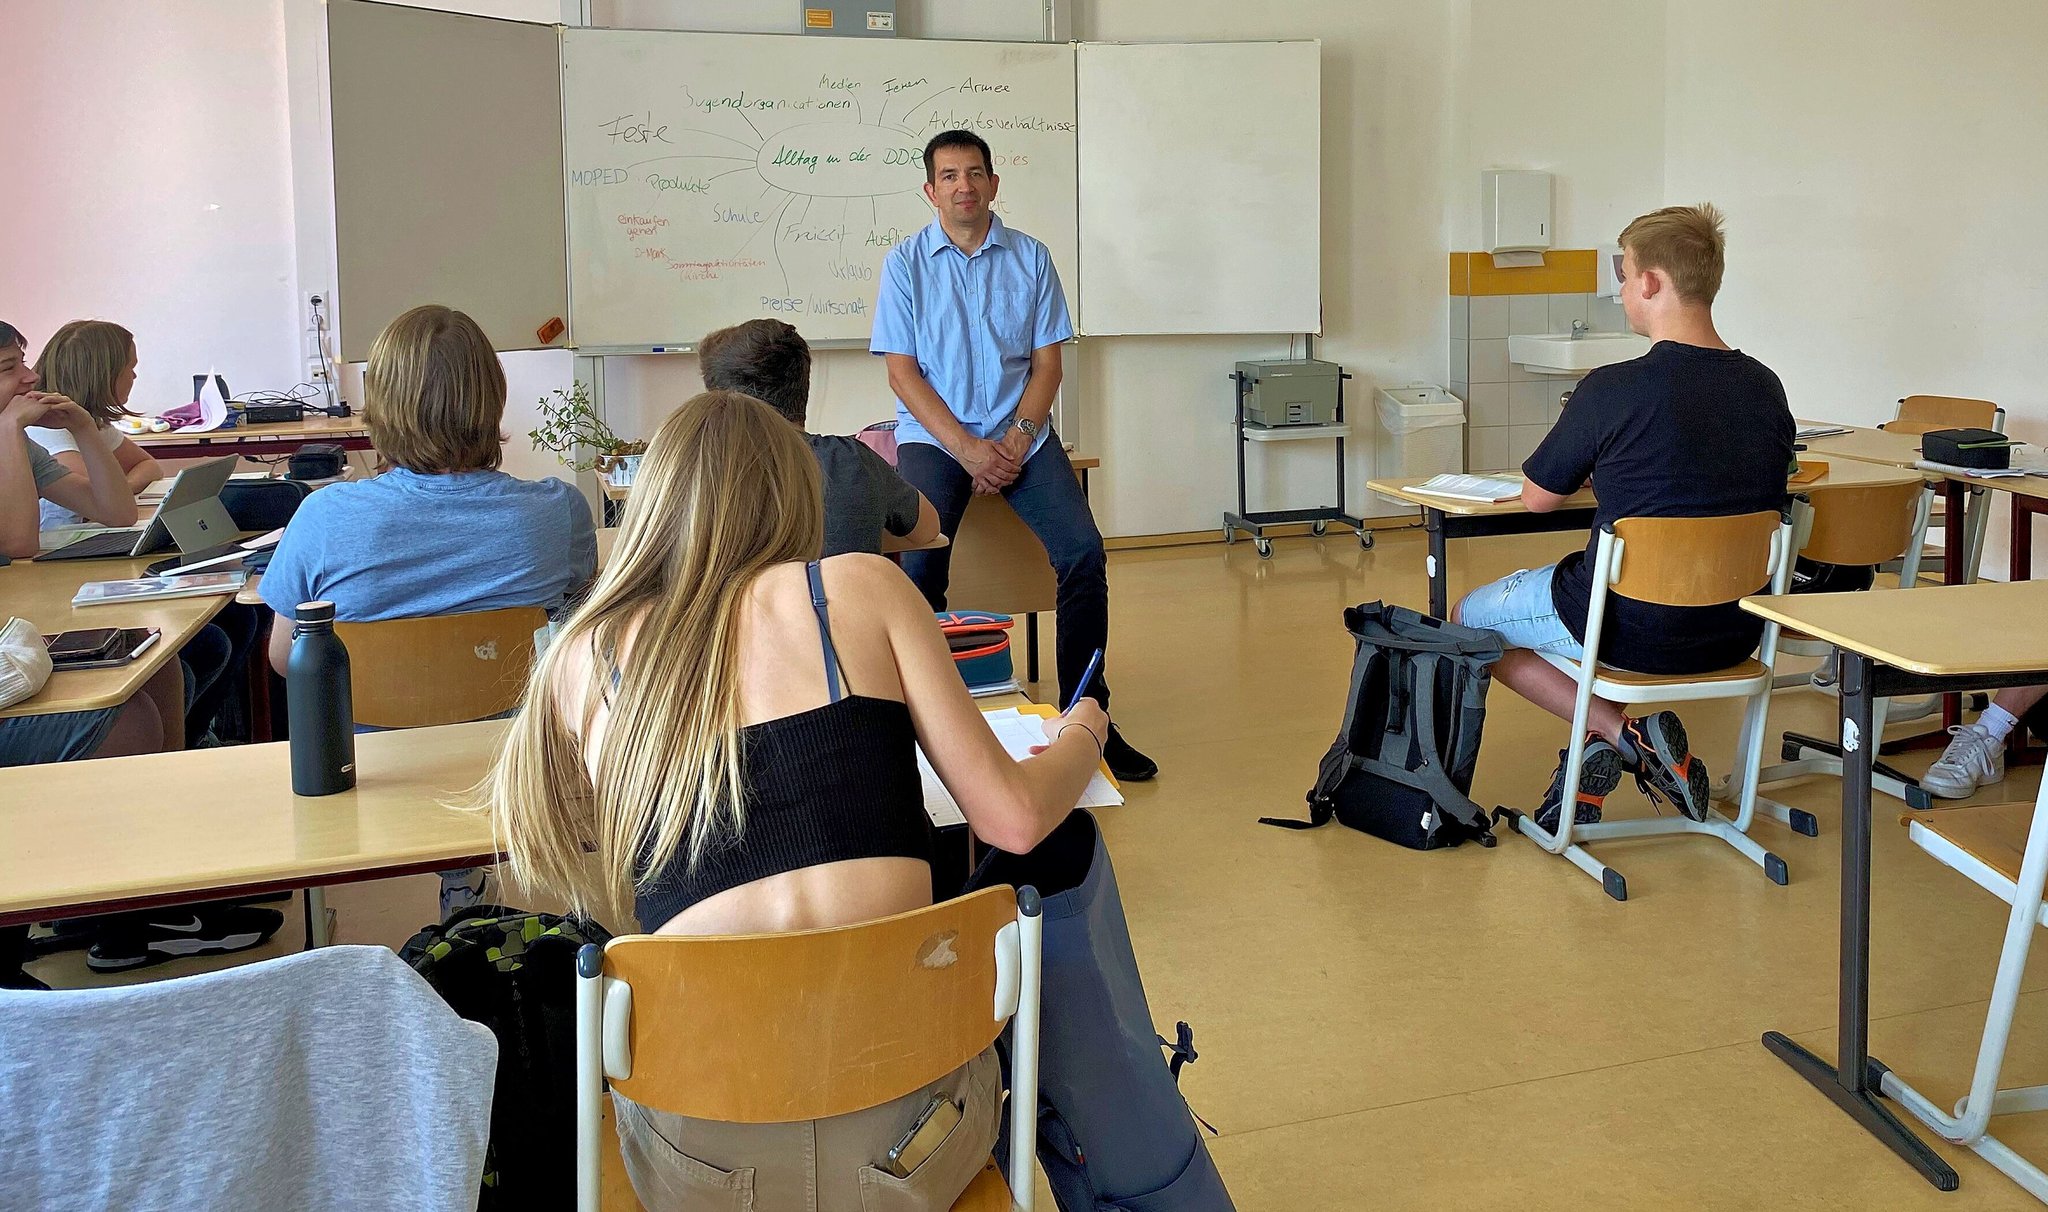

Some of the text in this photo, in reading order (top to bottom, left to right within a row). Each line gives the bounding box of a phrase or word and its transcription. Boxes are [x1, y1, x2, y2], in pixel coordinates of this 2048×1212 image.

[818, 73, 861, 90] Medien
[959, 77, 1010, 94] Armee
[598, 110, 675, 145] Feste
[772, 144, 819, 174] Alltag
[849, 147, 872, 162] der
[882, 147, 927, 169] DDR
[571, 167, 629, 188] MOPED
[646, 173, 711, 195] Produkte
[713, 202, 765, 225] Schule
[828, 257, 872, 281] Urlaub
